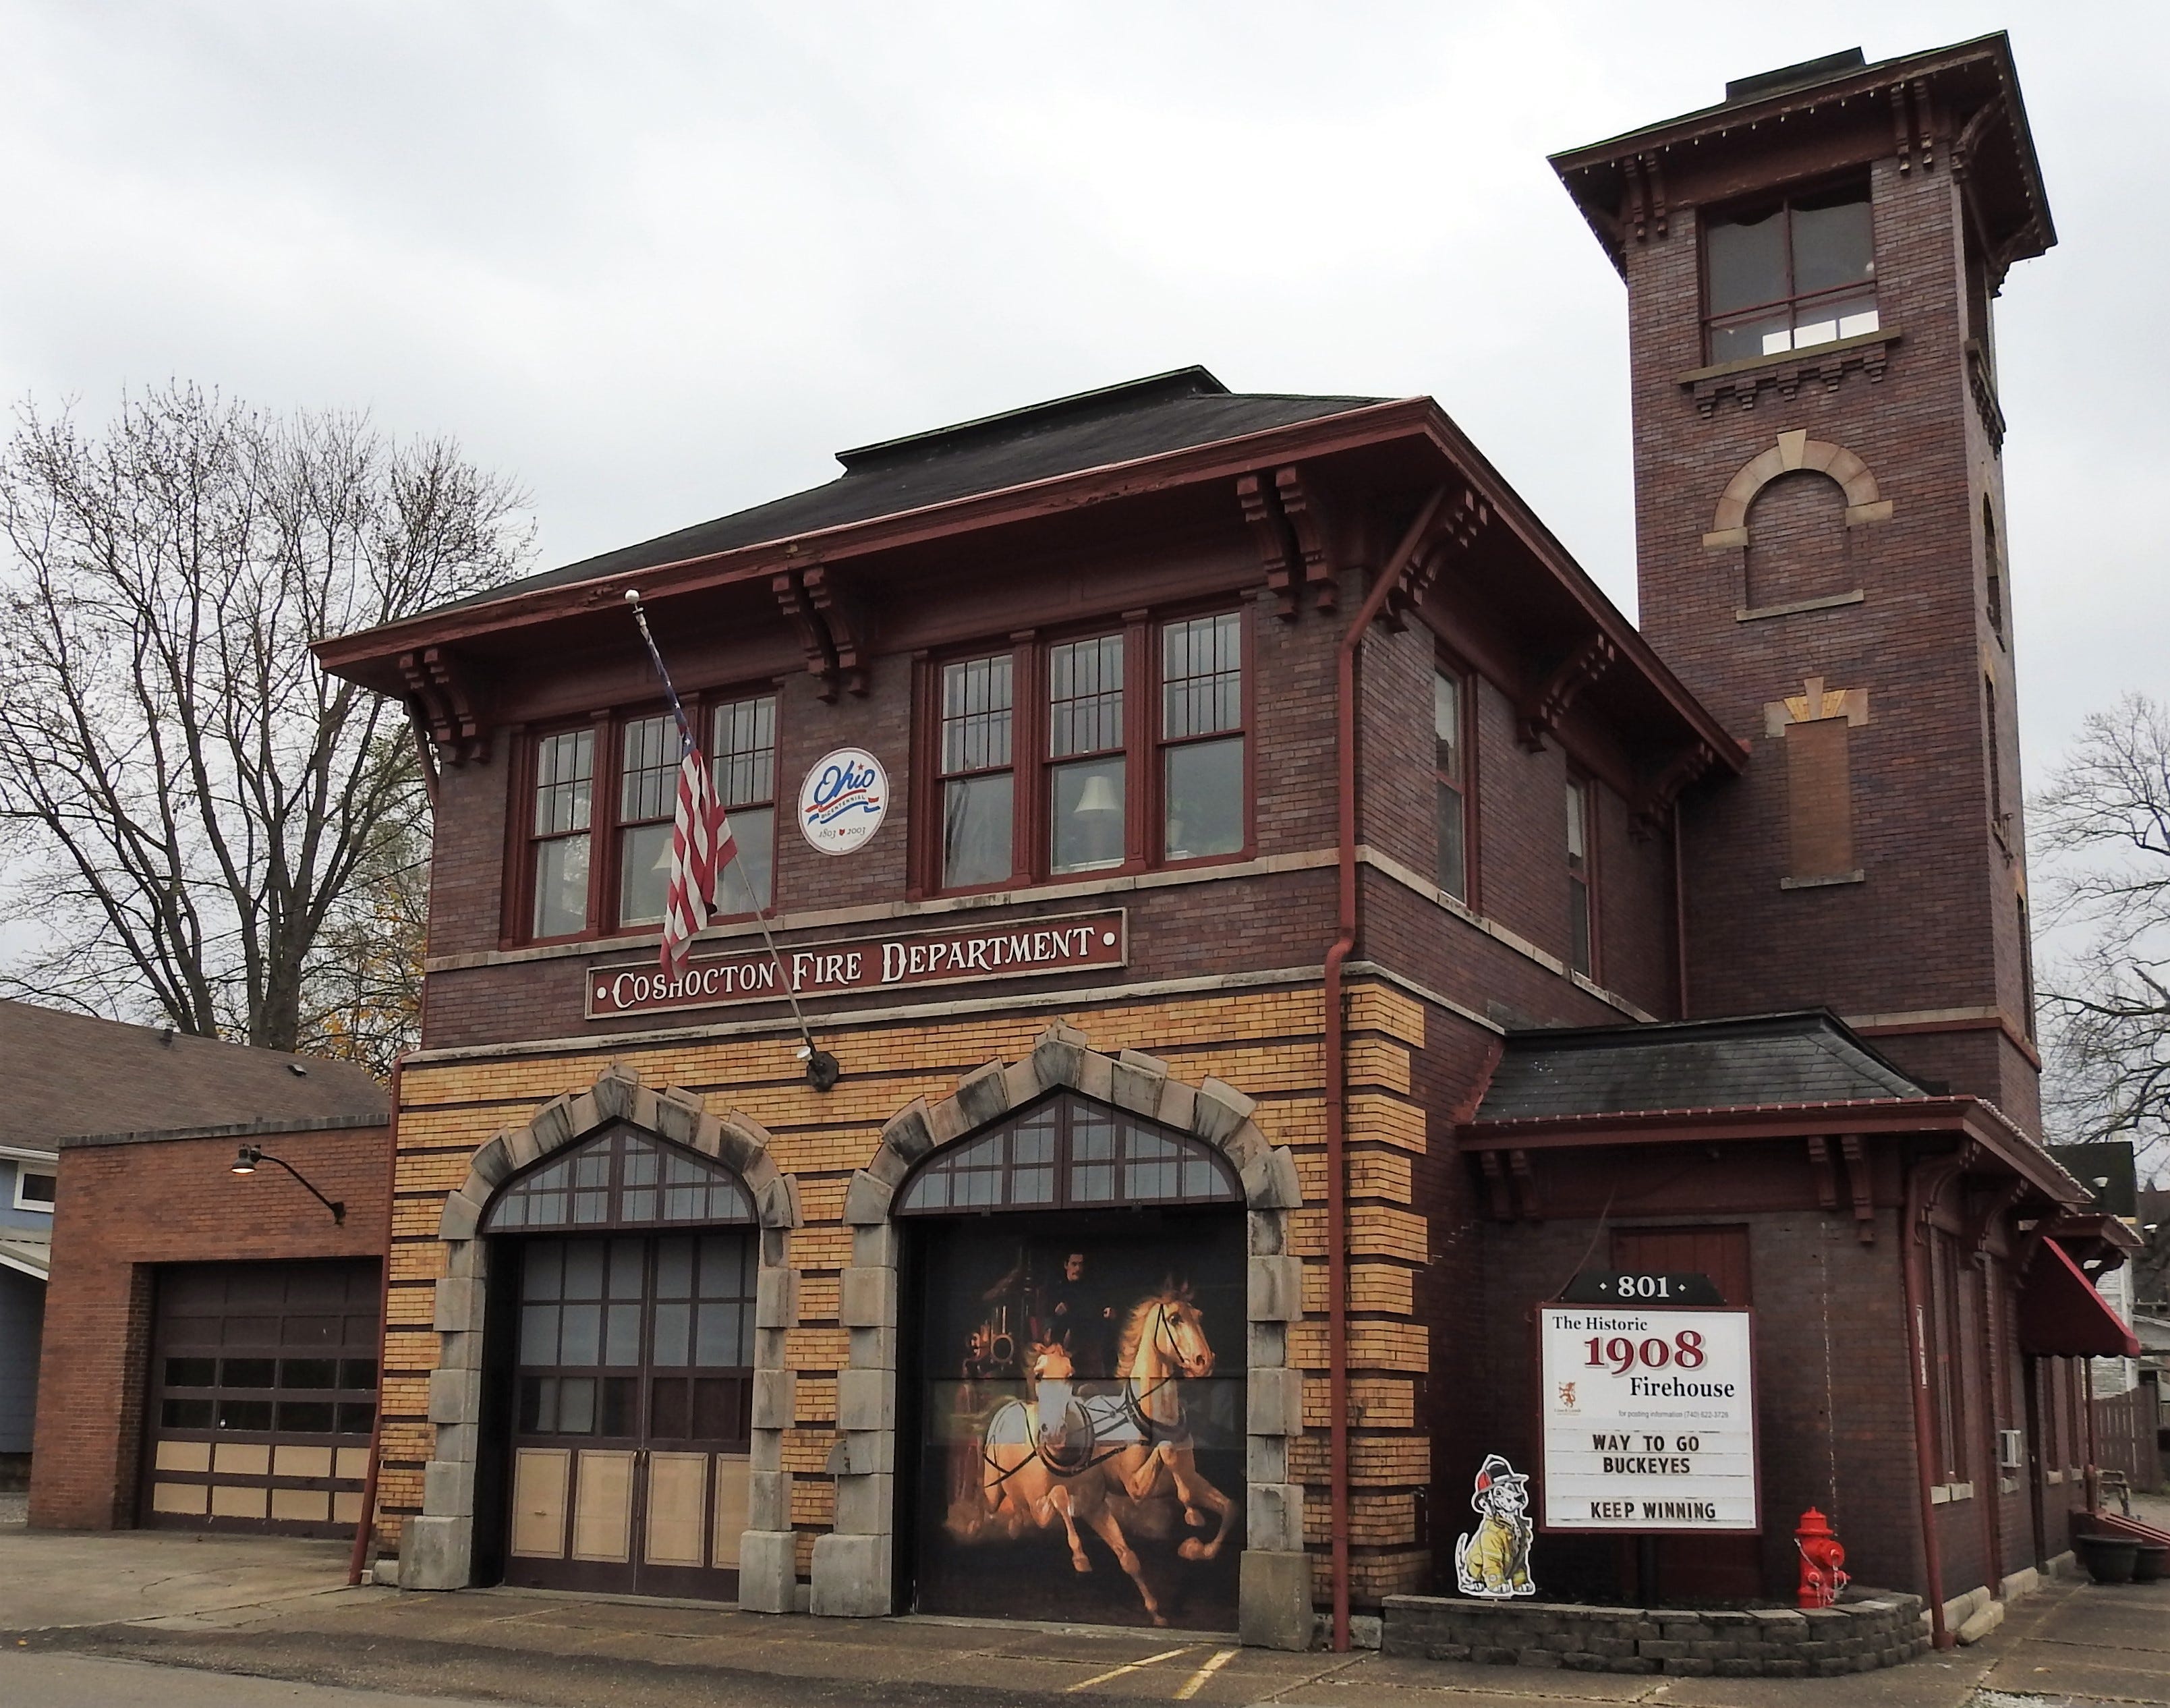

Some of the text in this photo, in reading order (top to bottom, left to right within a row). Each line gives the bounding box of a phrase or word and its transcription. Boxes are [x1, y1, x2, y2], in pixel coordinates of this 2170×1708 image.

[813, 760, 876, 805] Ohio
[821, 795, 866, 819] BICENTENNIAL
[819, 827, 866, 839] 1803 2003
[611, 927, 1095, 1008] COSHOCTON FIRE DEPARTMENT
[1618, 1276, 1670, 1298] 801
[1552, 1316, 1648, 1331] The Historic
[1584, 1330, 1706, 1375] 1908
[1630, 1377, 1735, 1398] Firehouse
[1592, 1434, 1699, 1452] WAY TO GO
[1603, 1457, 1690, 1474] BUCKEYES
[1591, 1502, 1715, 1519] KEEP WINNING
